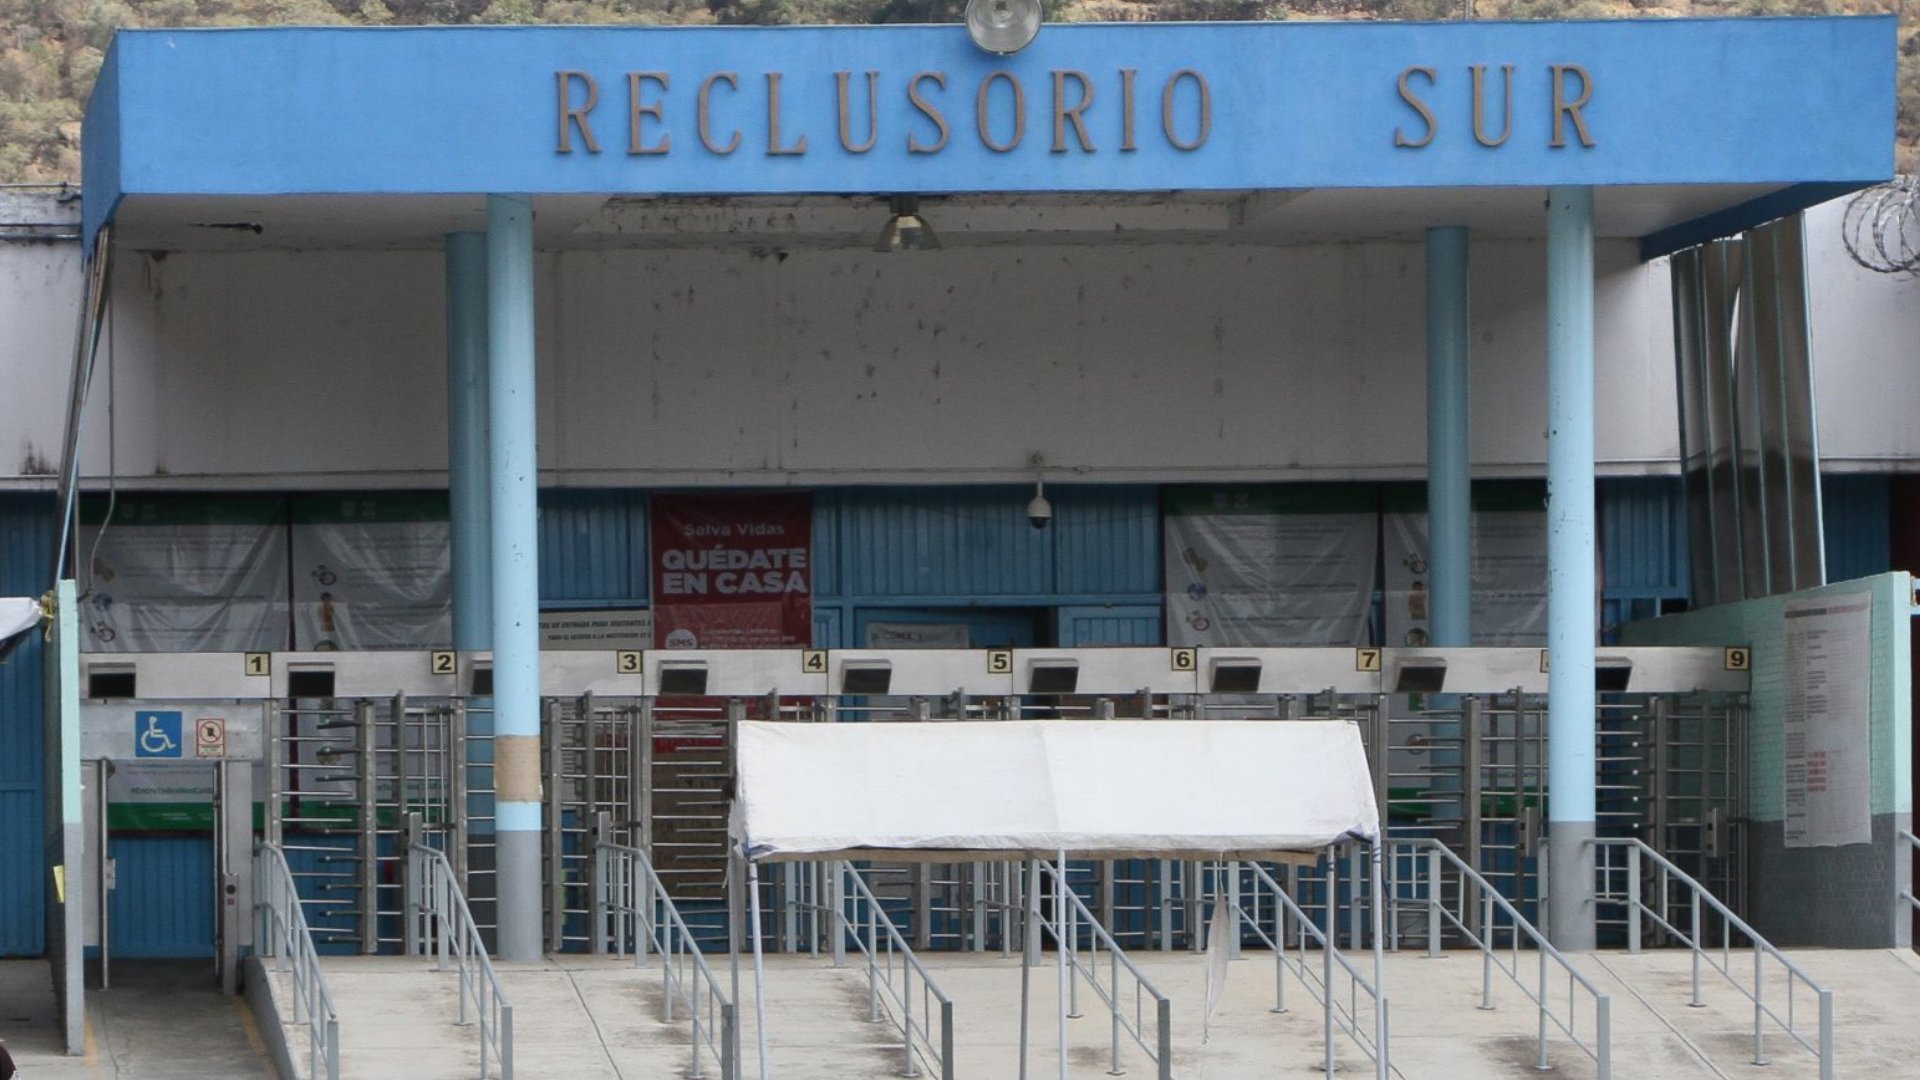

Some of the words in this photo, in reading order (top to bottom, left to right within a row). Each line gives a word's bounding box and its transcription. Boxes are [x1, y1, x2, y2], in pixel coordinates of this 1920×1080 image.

[554, 69, 1212, 155] RECLUSORIO
[1394, 64, 1597, 149] SUR
[684, 523, 731, 537] Salva
[738, 522, 785, 536] Vidas
[661, 544, 807, 571] QUÉDATE
[662, 572, 709, 594] EN
[714, 571, 808, 594] CASA
[250, 655, 264, 673] 1
[437, 655, 452, 672] 2
[623, 653, 638, 671] 3
[807, 653, 823, 670] 4
[993, 653, 1008, 670] 5
[1175, 652, 1191, 668] 6
[1361, 651, 1377, 668] 7
[1730, 650, 1745, 667] 9
